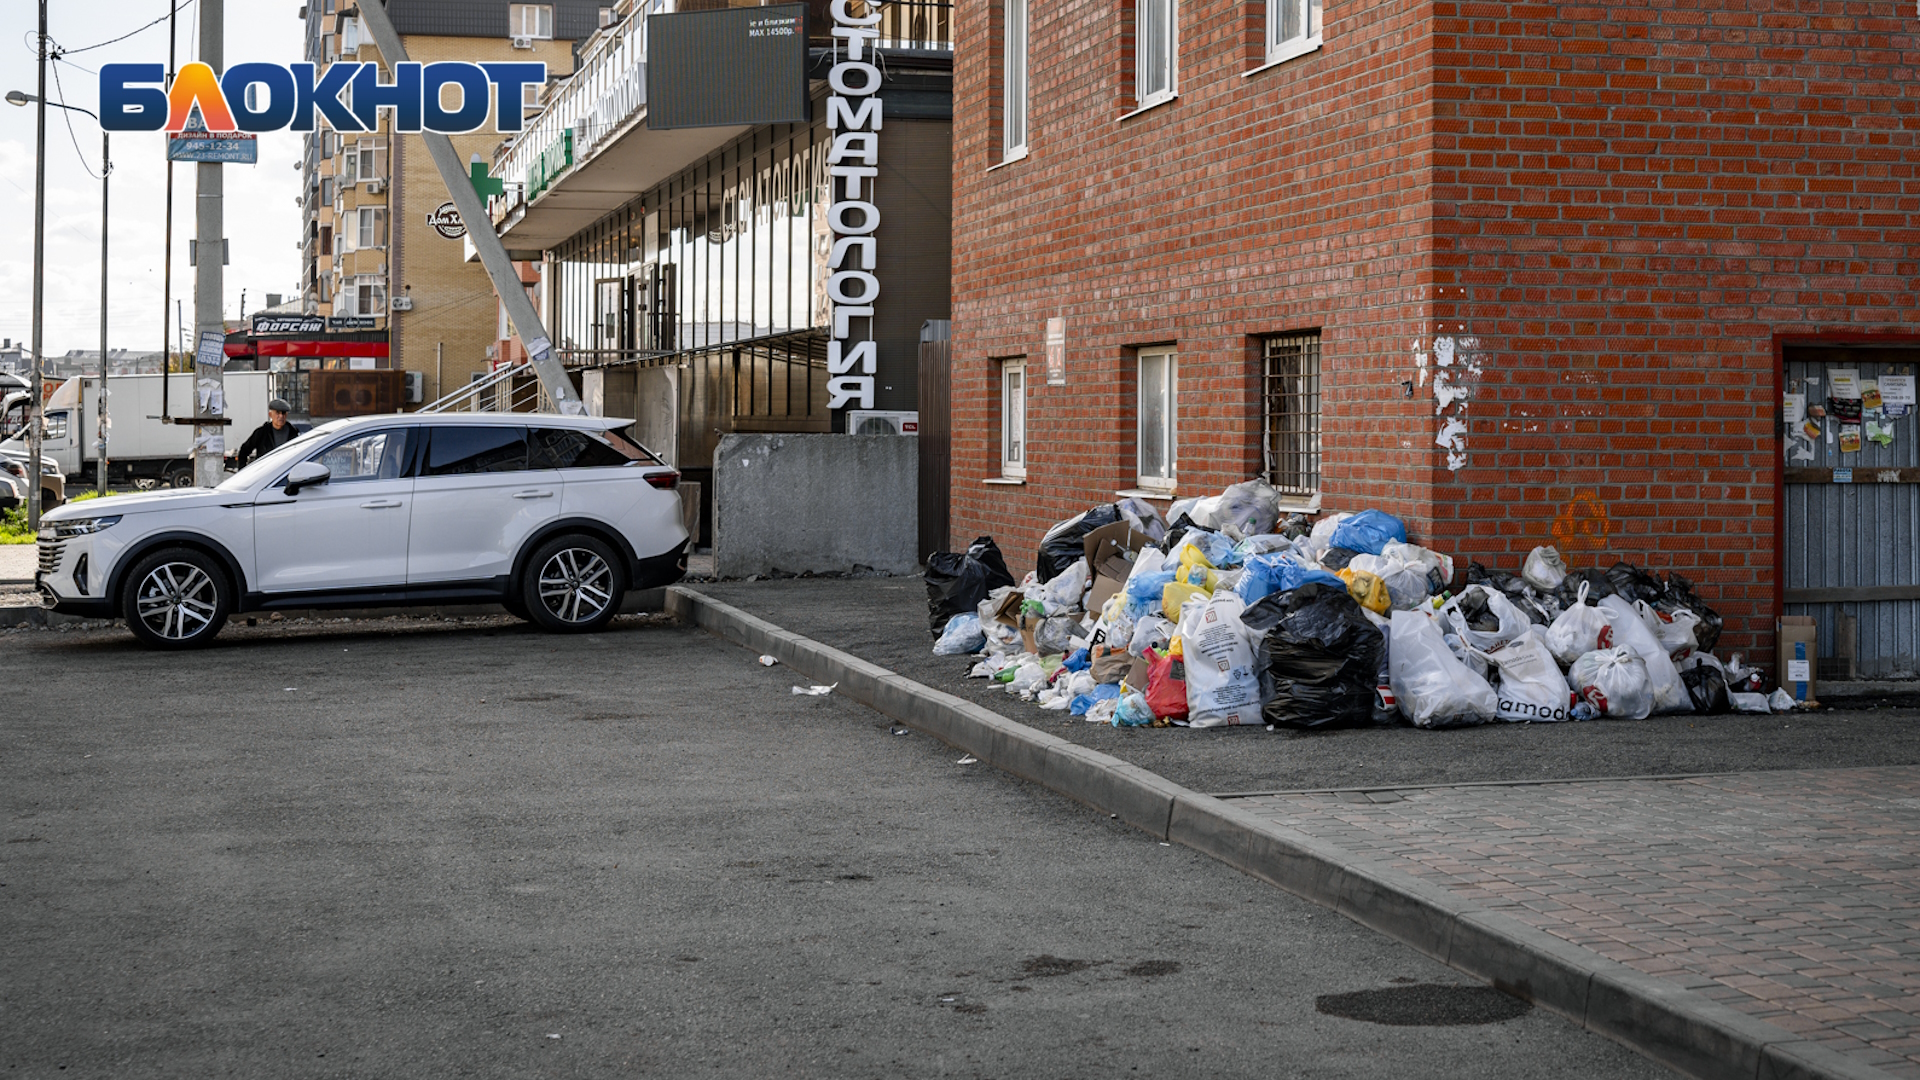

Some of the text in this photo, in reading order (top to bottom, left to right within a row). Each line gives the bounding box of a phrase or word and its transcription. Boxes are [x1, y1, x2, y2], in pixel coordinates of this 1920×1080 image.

[186, 142, 239, 150] 945-12-34
[826, 0, 883, 409] СТОМАТОЛОГИЯ
[257, 321, 322, 332] ФОРСАЖ
